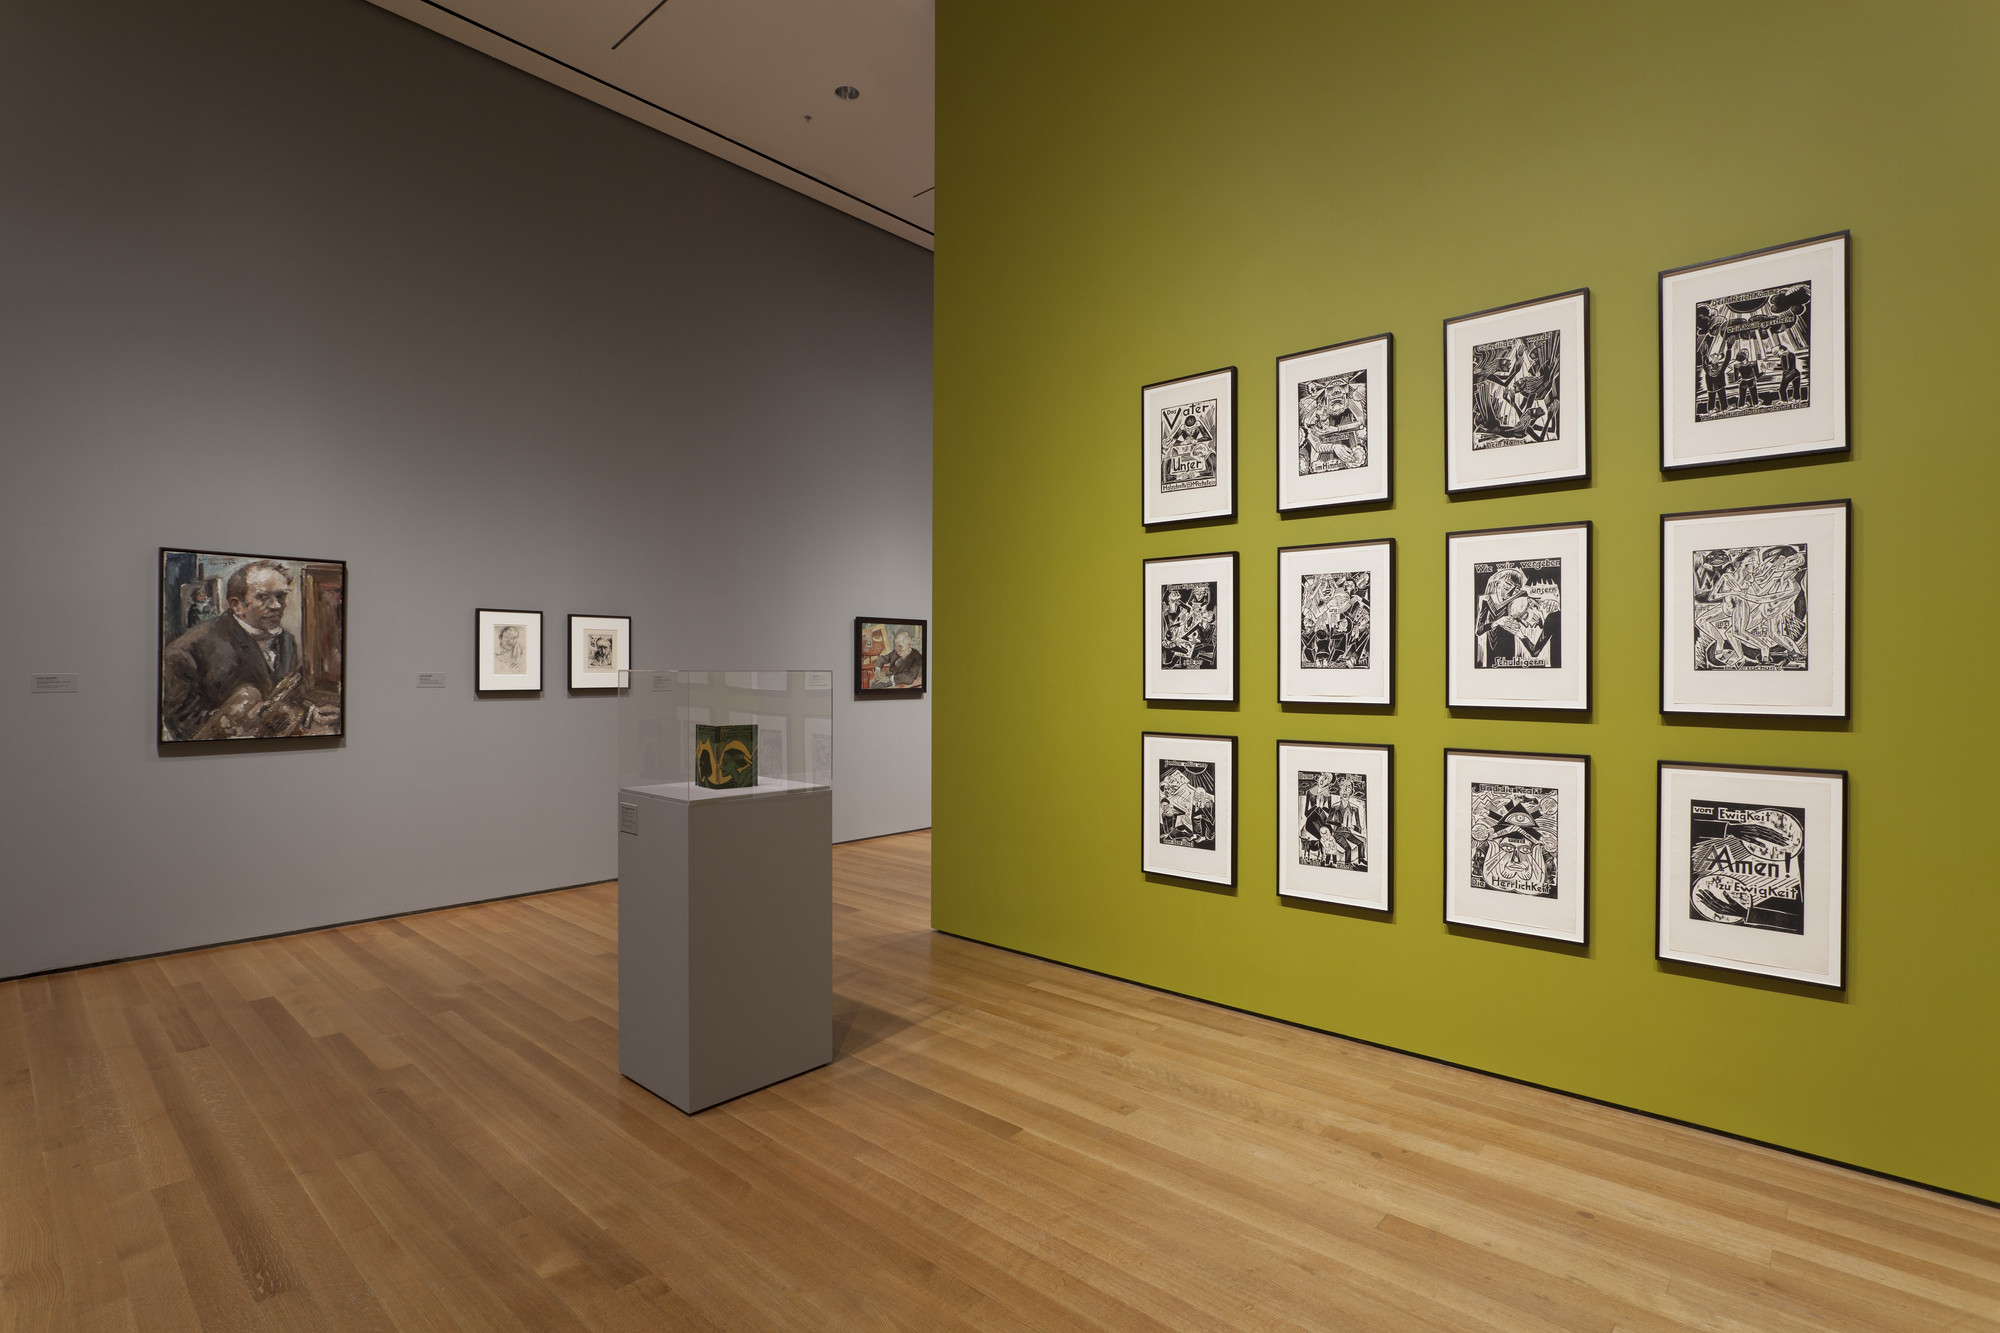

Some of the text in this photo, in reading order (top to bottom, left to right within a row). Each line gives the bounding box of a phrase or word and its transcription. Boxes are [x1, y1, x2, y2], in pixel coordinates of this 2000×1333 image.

[1162, 403, 1209, 431] Vater
[1475, 558, 1561, 573] Wie wir vergeben
[1492, 656, 1545, 669] Schuldigern
[1693, 806, 1713, 814] von
